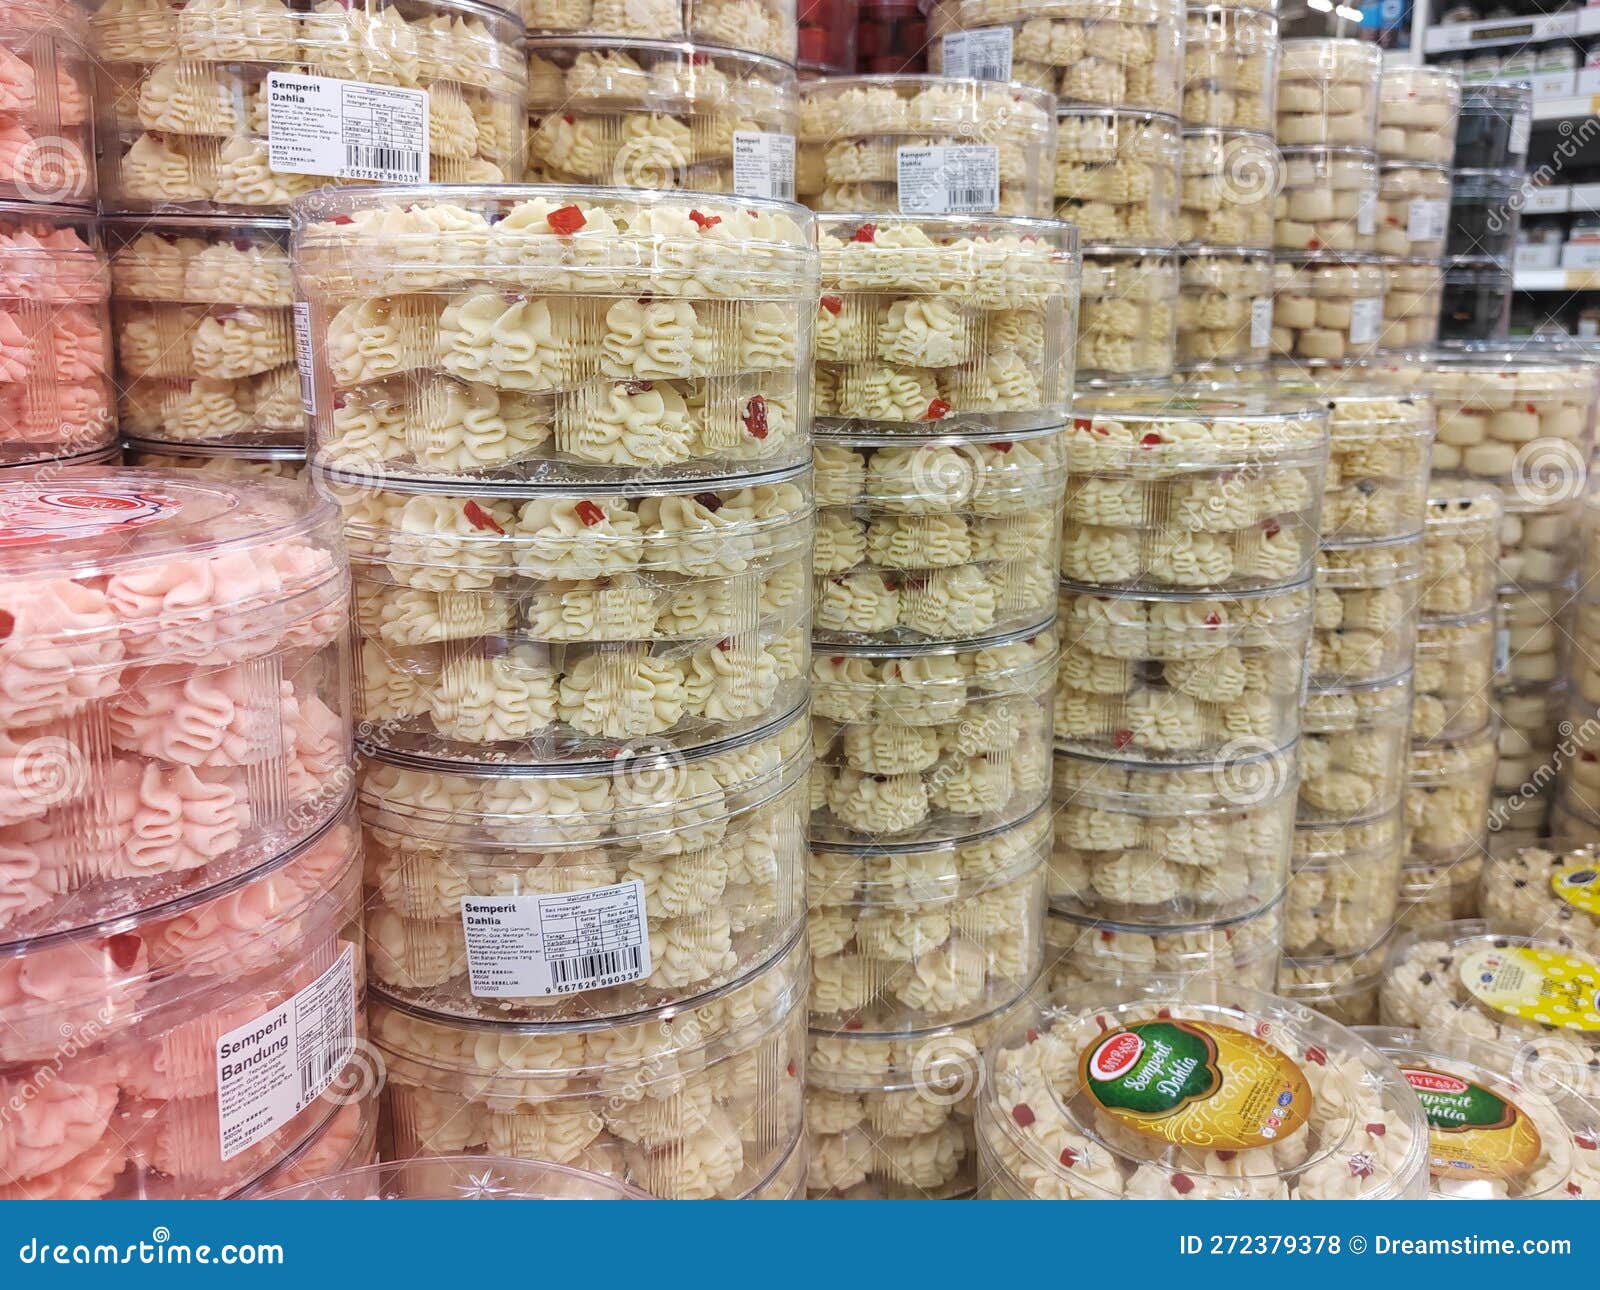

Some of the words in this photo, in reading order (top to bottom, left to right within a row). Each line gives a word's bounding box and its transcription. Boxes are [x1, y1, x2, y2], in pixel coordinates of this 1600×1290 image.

[271, 80, 321, 93] Semperit
[272, 93, 305, 103] Dahlia
[465, 903, 517, 915] Semperit
[467, 917, 501, 925] Dahlia
[220, 1013, 288, 1060] Semperit
[221, 1035, 289, 1082] Bandung
[1123, 1040, 1173, 1091] Semperit
[1157, 1057, 1198, 1098] Dahlia
